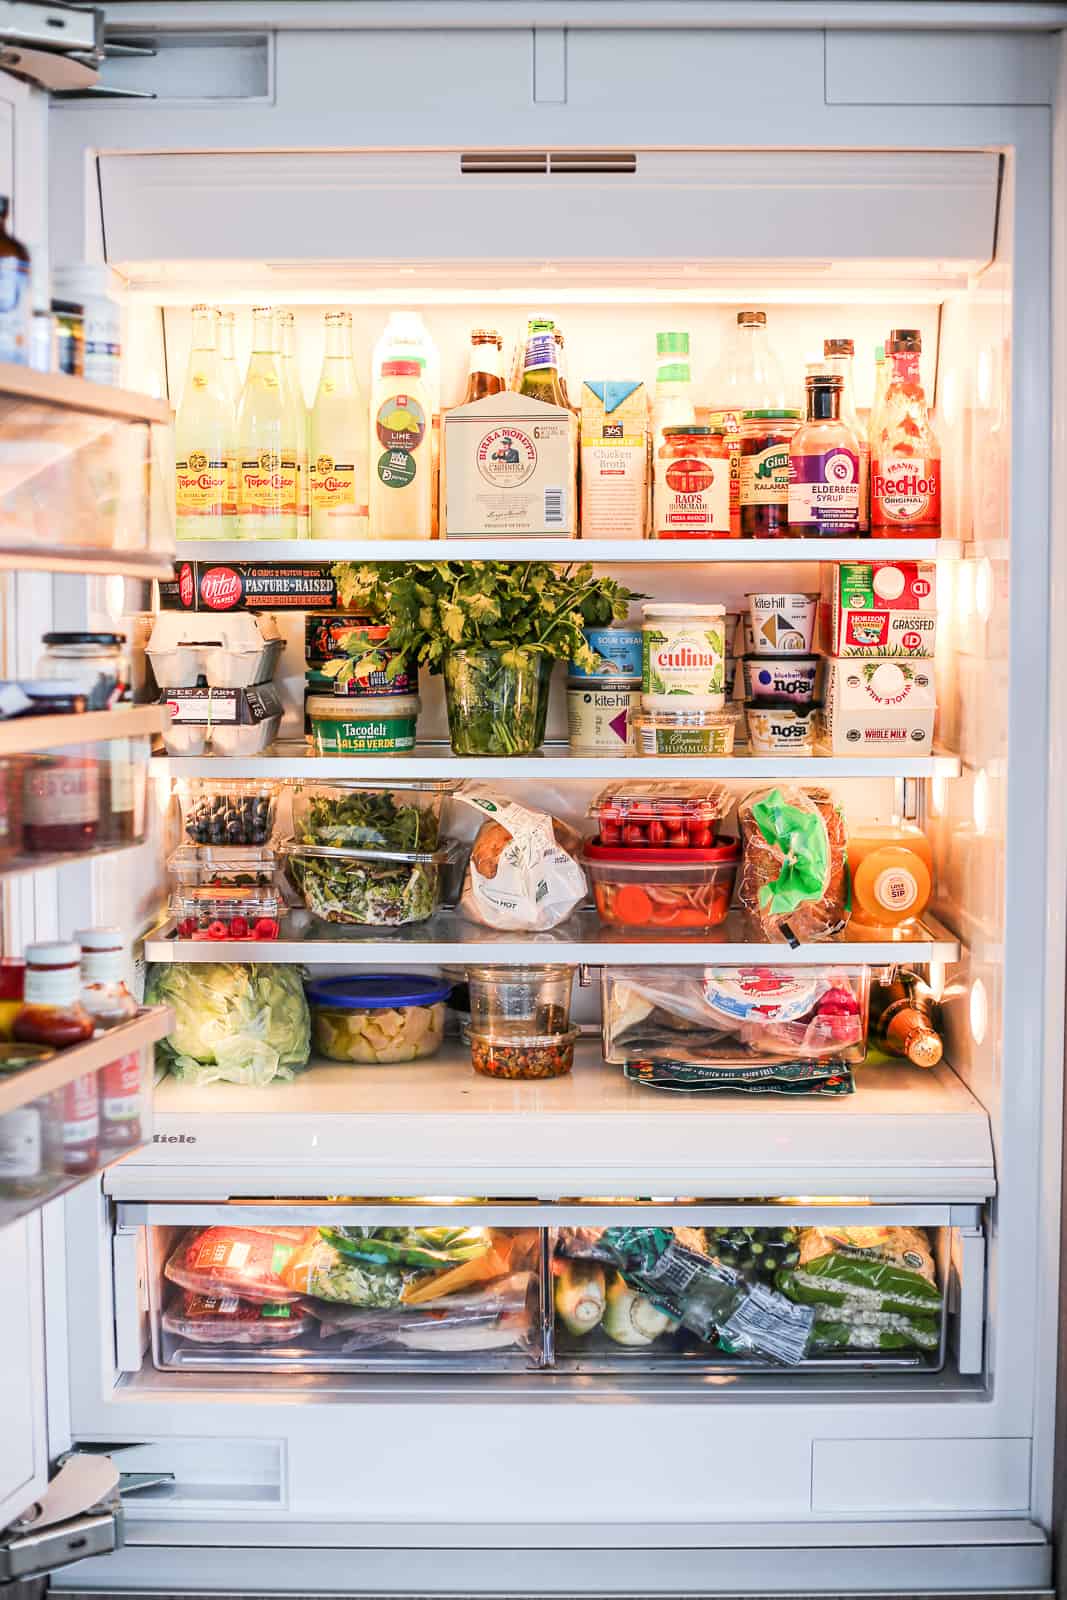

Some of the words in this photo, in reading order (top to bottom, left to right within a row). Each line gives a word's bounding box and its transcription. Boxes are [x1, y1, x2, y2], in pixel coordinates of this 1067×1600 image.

[391, 432, 411, 440] LIME
[480, 431, 500, 460] BIRRA
[502, 429, 535, 460] MORETTI
[675, 494, 702, 504] RAO'S
[816, 494, 843, 502] SYRUP
[206, 573, 237, 598] Vital
[245, 579, 334, 593] PASTURE-RAISED
[851, 615, 886, 623] HORIZON
[892, 620, 935, 630] GRASSFED
[658, 648, 713, 666] culina
[342, 723, 387, 737] Tacodeli
[865, 730, 889, 739] WHOLE
[890, 730, 907, 739] MILK
[366, 738, 395, 748] VERDE
[665, 745, 710, 753] HUMMUS
[891, 890, 905, 898] SIP
[499, 901, 517, 909] HOT
